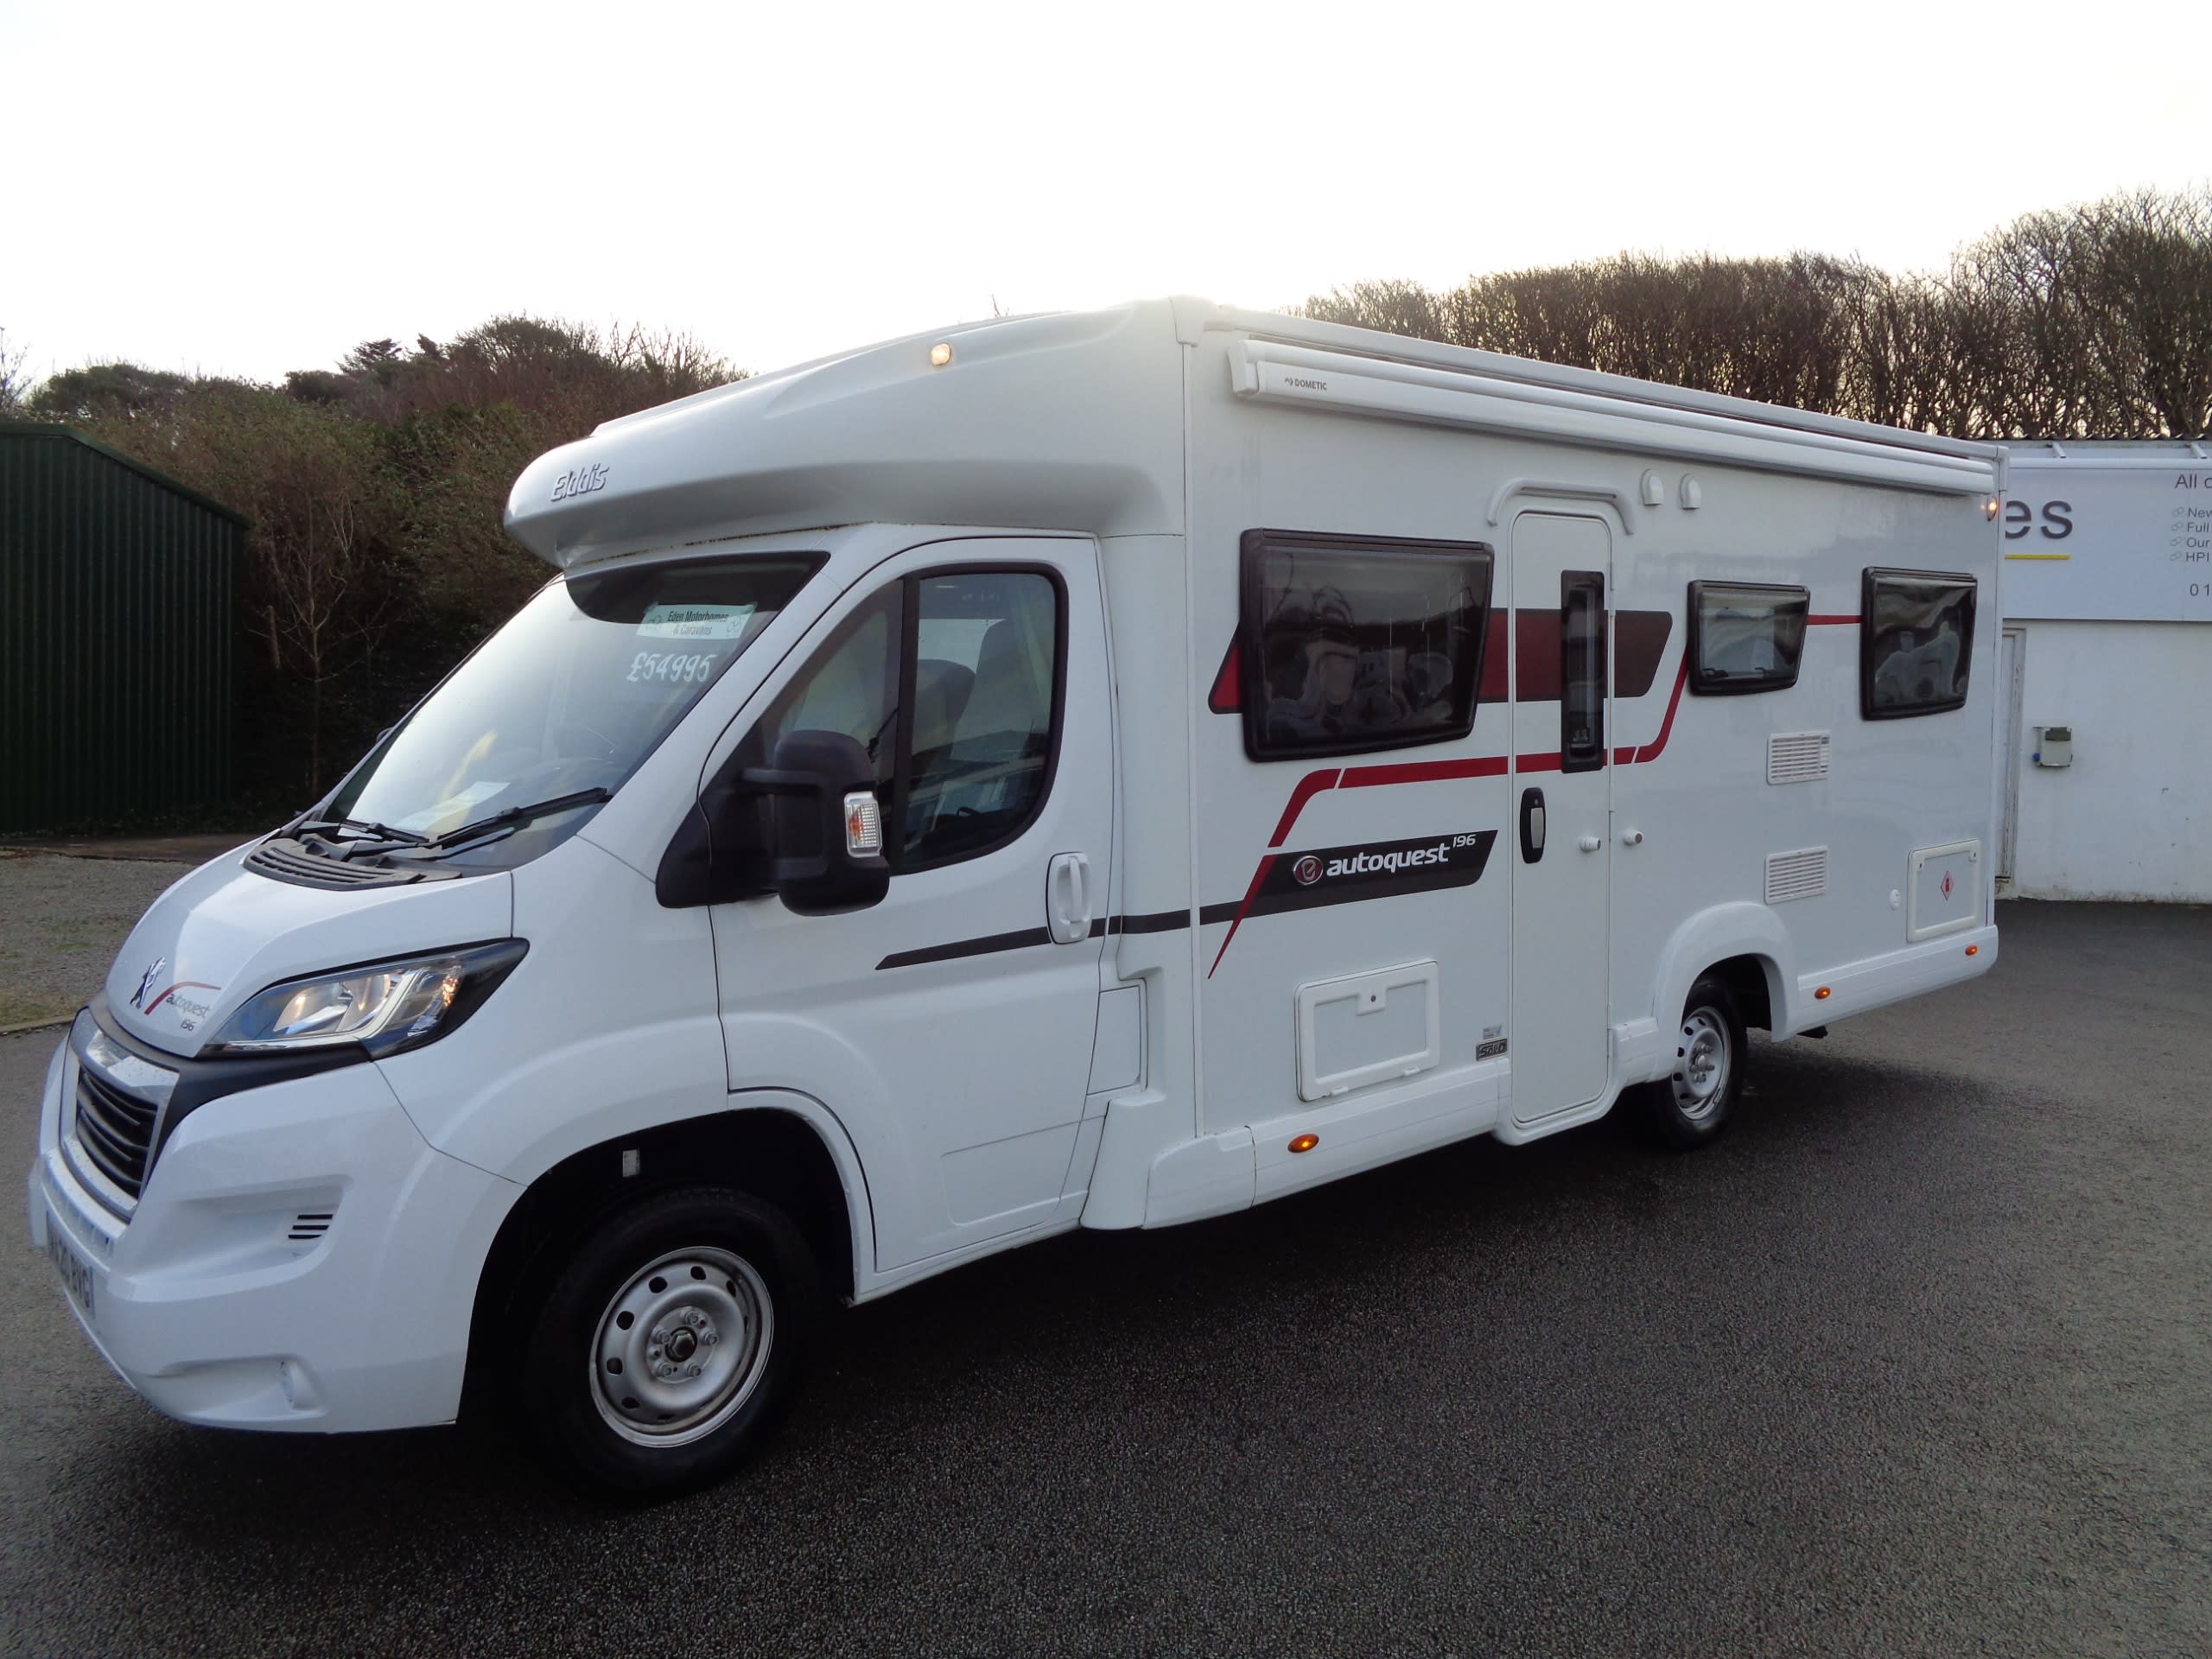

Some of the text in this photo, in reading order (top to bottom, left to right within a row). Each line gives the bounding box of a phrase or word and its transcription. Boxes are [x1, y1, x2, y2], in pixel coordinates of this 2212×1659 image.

[1294, 378, 1327, 391] DOMETIC
[2175, 474, 2197, 489] All
[2186, 522, 2209, 533] Full
[2185, 537, 2210, 548] Our
[2184, 552, 2209, 563] HPI
[667, 610, 729, 623] Eden Motorhomes
[680, 625, 712, 636] Caravans
[626, 652, 718, 683] £54995
[1326, 842, 1451, 876] autoquest
[1452, 834, 1477, 849] 196
[165, 993, 210, 1018] autoquest
